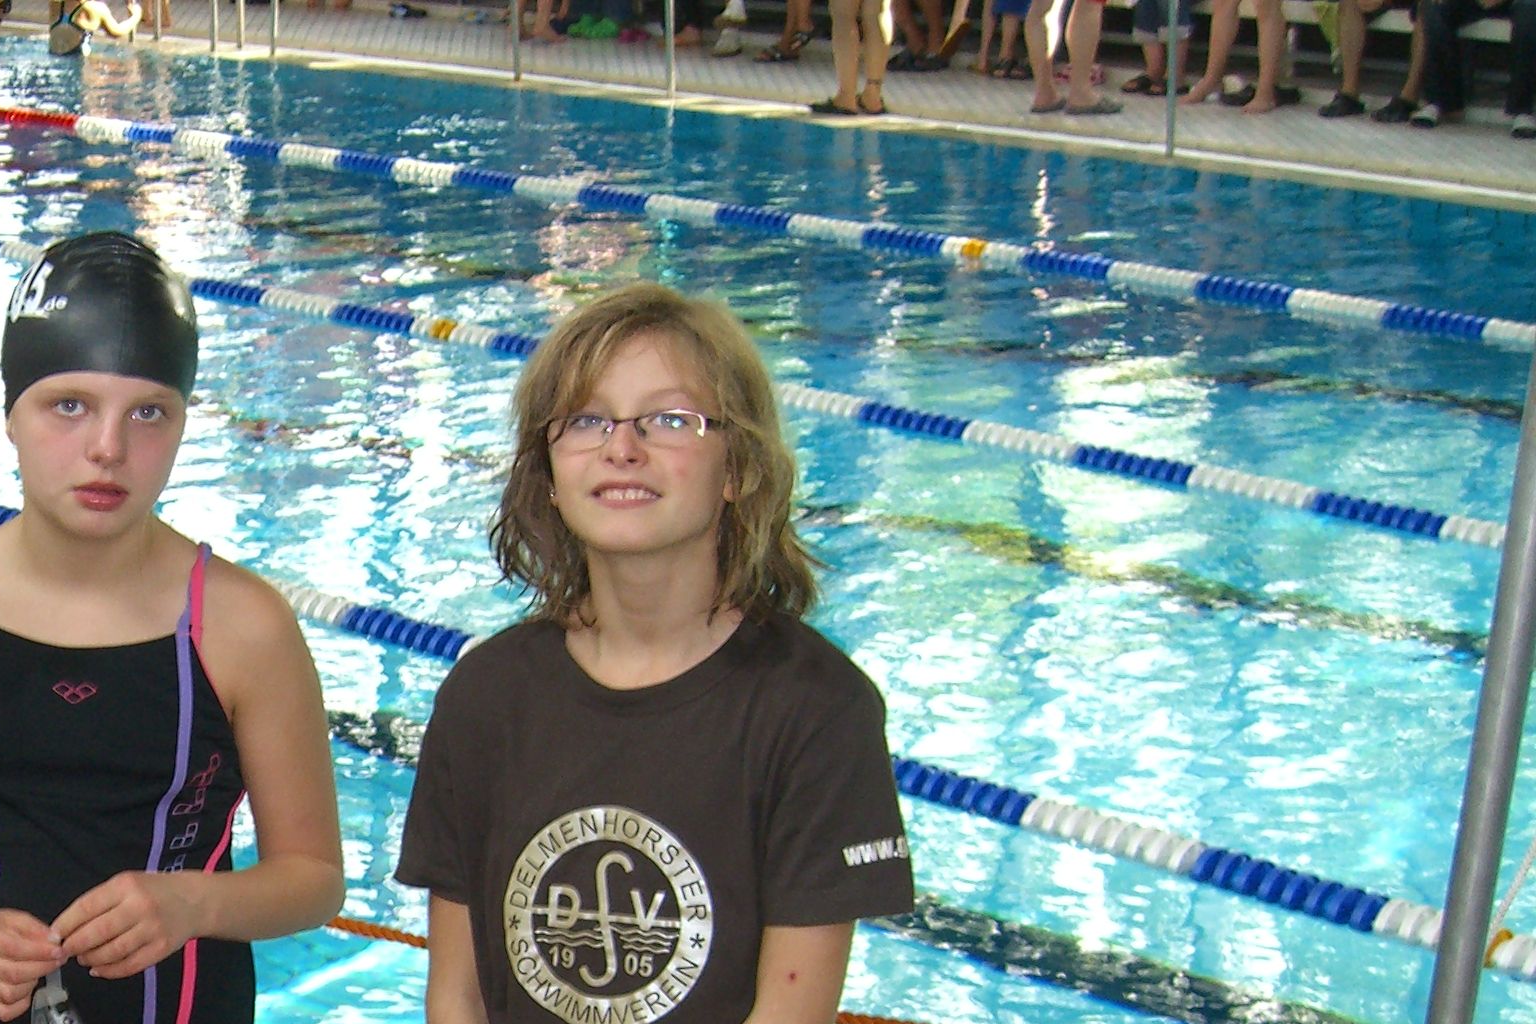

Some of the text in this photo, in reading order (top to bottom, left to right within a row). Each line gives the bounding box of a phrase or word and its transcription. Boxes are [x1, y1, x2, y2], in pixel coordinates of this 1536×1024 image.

[510, 813, 707, 922] DELMENHORSTER
[548, 945, 654, 977] 19 05
